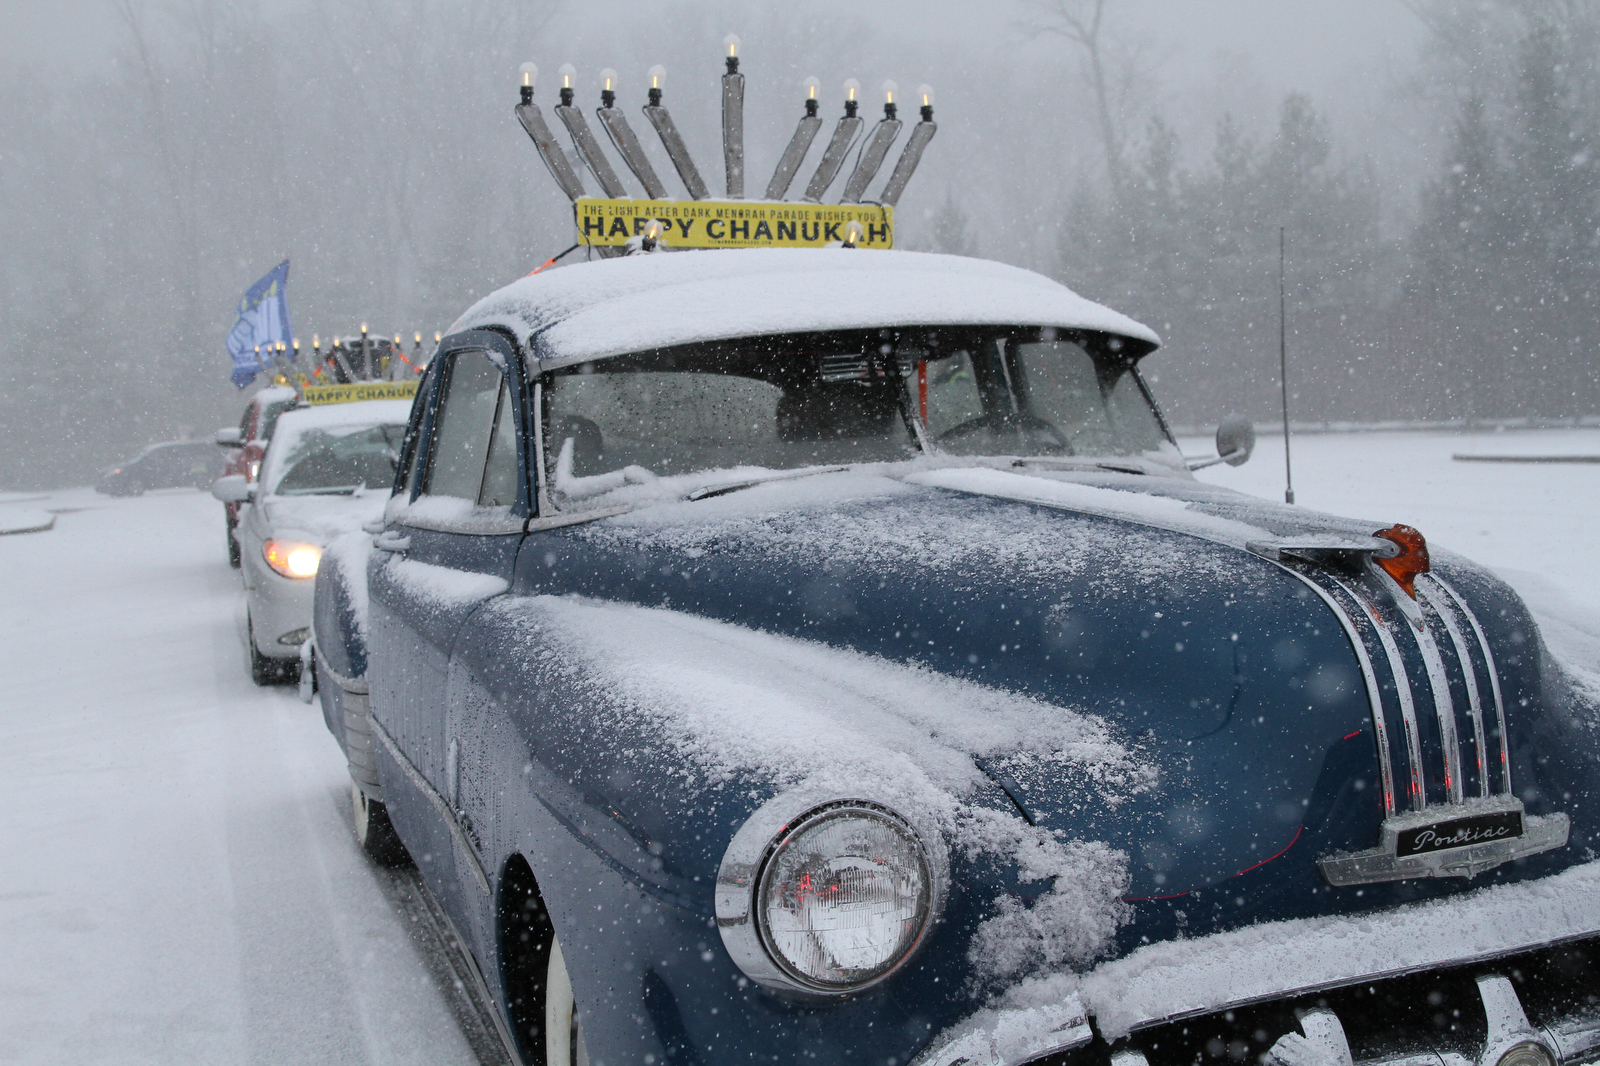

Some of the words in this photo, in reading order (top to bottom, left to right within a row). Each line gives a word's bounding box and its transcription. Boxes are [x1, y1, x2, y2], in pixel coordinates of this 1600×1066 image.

[584, 205, 603, 215] THE
[609, 206, 639, 216] LIGHT
[645, 206, 678, 217] AFTER
[684, 207, 710, 218] DARK
[716, 208, 765, 219] MENORAH
[770, 210, 809, 220] PARADE
[815, 211, 852, 221] WISHES
[857, 212, 876, 222] YOU
[706, 219, 886, 242] CHANUKH
[306, 391, 351, 401] HAPPY
[357, 387, 415, 400] CHANUK
[1412, 826, 1510, 850] Pontiac
